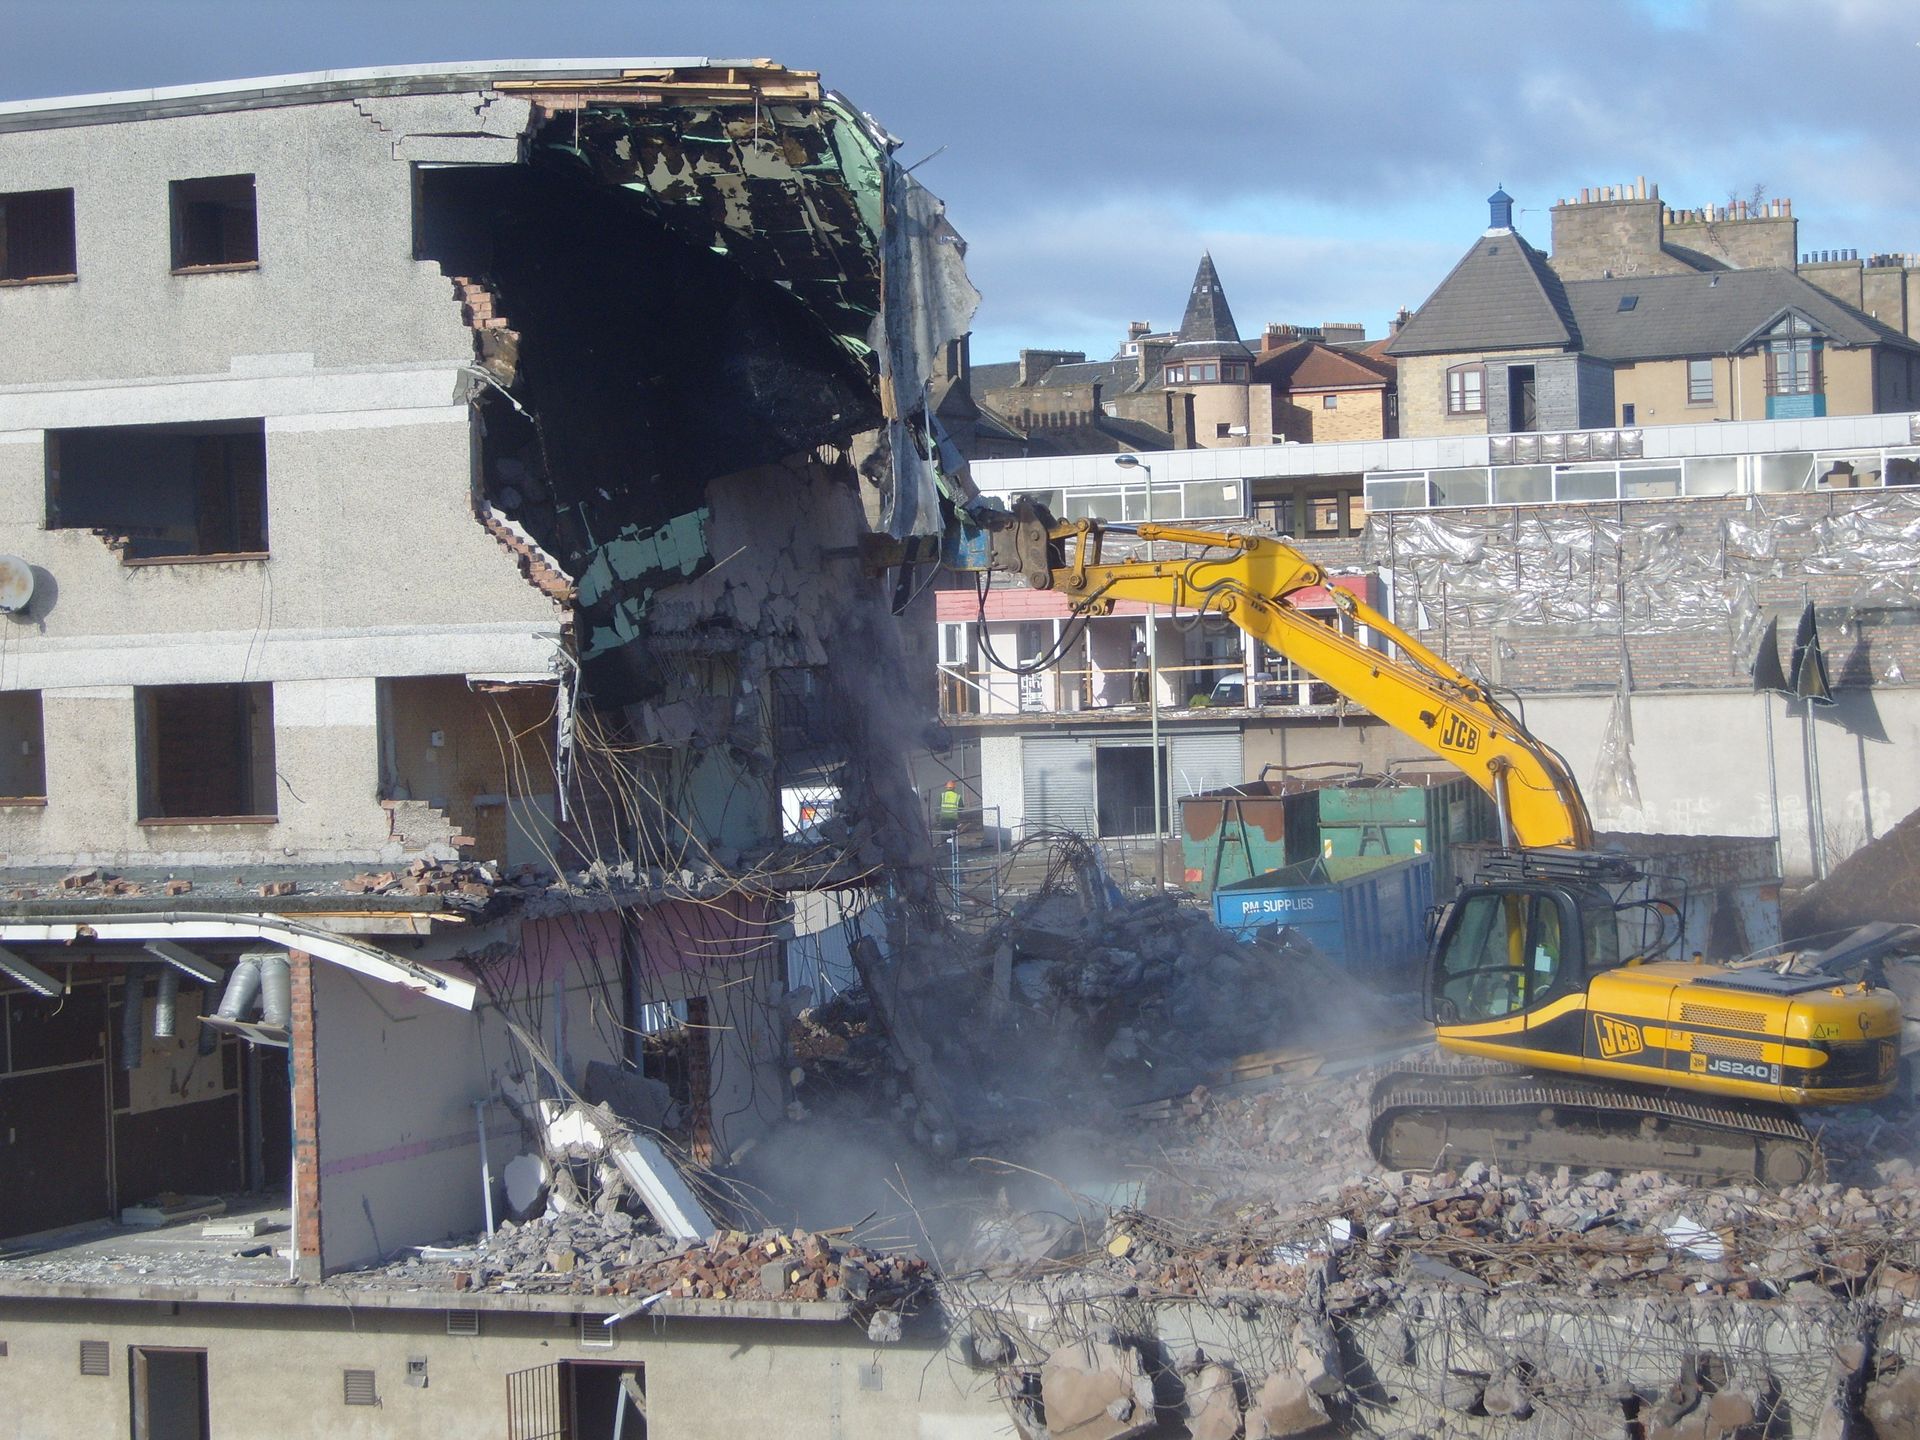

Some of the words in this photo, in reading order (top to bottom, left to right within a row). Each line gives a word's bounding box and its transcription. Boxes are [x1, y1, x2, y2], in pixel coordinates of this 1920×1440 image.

[1443, 713, 1477, 750] JCB
[1263, 898, 1313, 913] SUPPLIES
[1602, 1019, 1640, 1055] JCB
[1708, 1059, 1769, 1078] JS240
